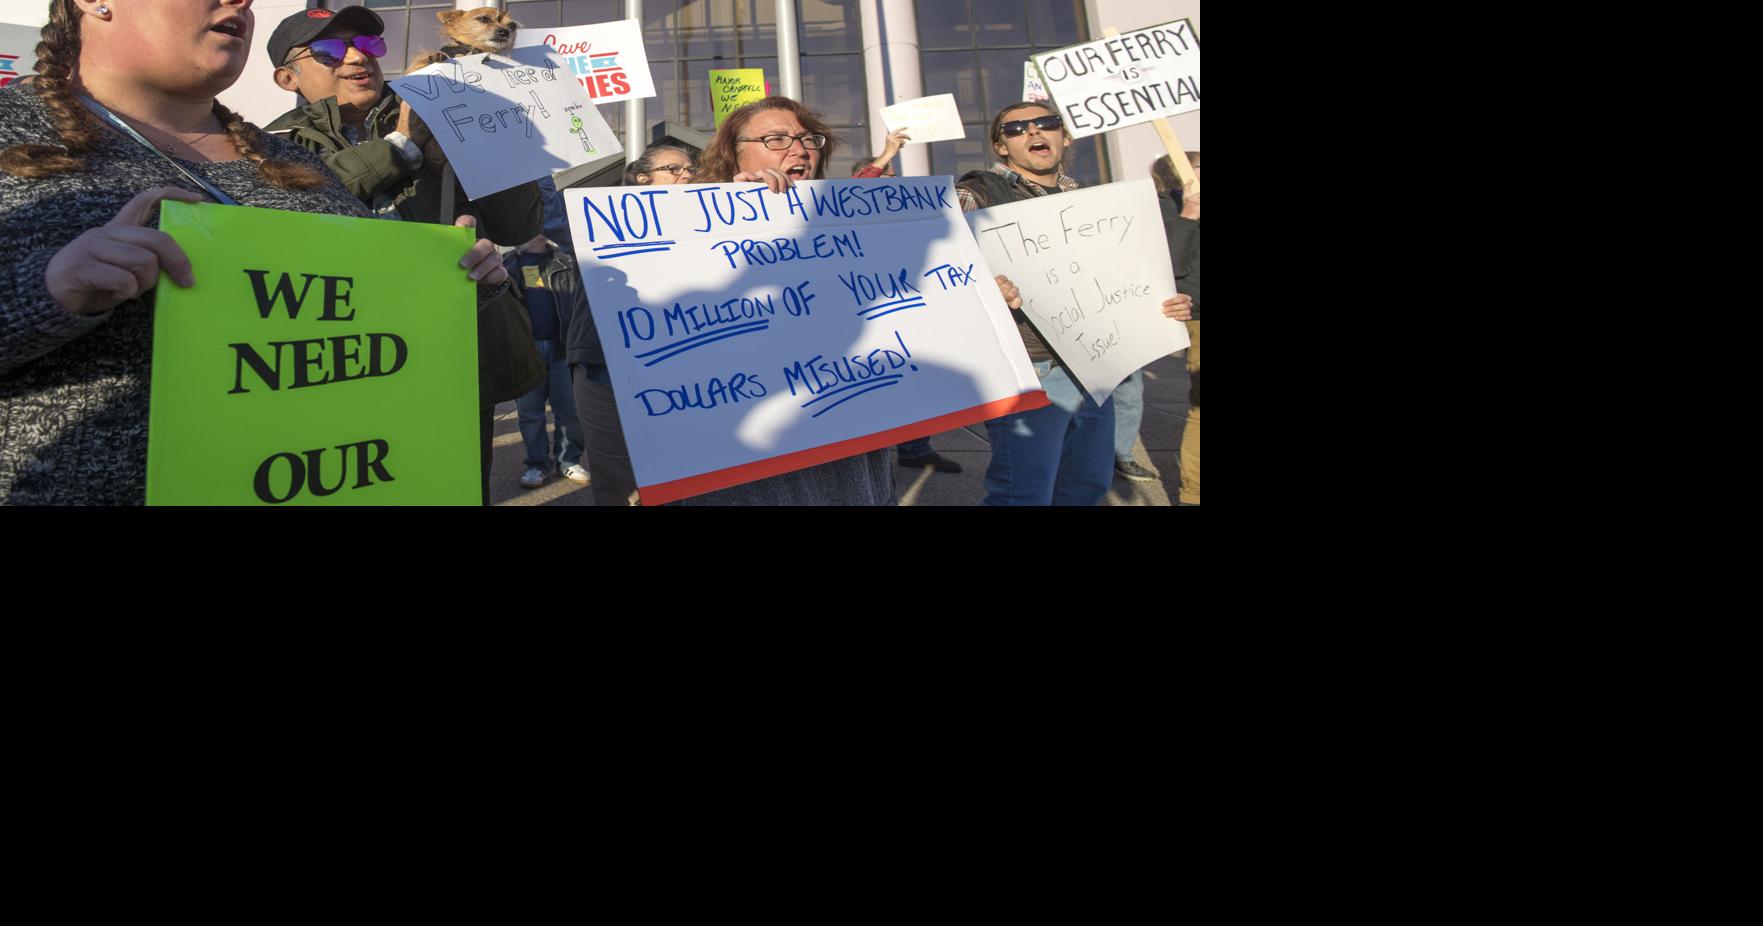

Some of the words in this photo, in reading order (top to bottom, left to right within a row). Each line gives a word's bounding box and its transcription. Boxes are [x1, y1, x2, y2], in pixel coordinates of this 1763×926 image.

[400, 63, 485, 101] We
[500, 59, 557, 89] need
[1044, 47, 1114, 81] OUR
[1105, 24, 1189, 66] FERRY
[1122, 67, 1139, 80] IS
[442, 90, 550, 143] Ferry!
[1065, 76, 1200, 131] ESSENTIAL
[583, 190, 668, 242] NOT
[684, 187, 769, 233] JUST
[786, 185, 808, 221] A
[810, 184, 952, 218] WESTBANK
[981, 220, 1050, 263] The
[1059, 205, 1134, 247] Ferry
[710, 230, 864, 269] PROBLEM!
[1045, 267, 1059, 285] is
[1068, 261, 1080, 274] a
[243, 269, 356, 321] WE
[617, 307, 655, 349] 10
[663, 294, 776, 337] MILLION
[783, 280, 816, 317] OF
[838, 268, 921, 306] YOUR
[924, 263, 976, 290] TAX
[1029, 288, 1085, 342] Social
[1094, 278, 1151, 313] Justice
[227, 333, 408, 394] NEED
[1075, 320, 1121, 362] Issue!
[634, 373, 767, 416] DOLLARS
[783, 331, 918, 396] MISUSED!
[253, 439, 395, 504] OUR
